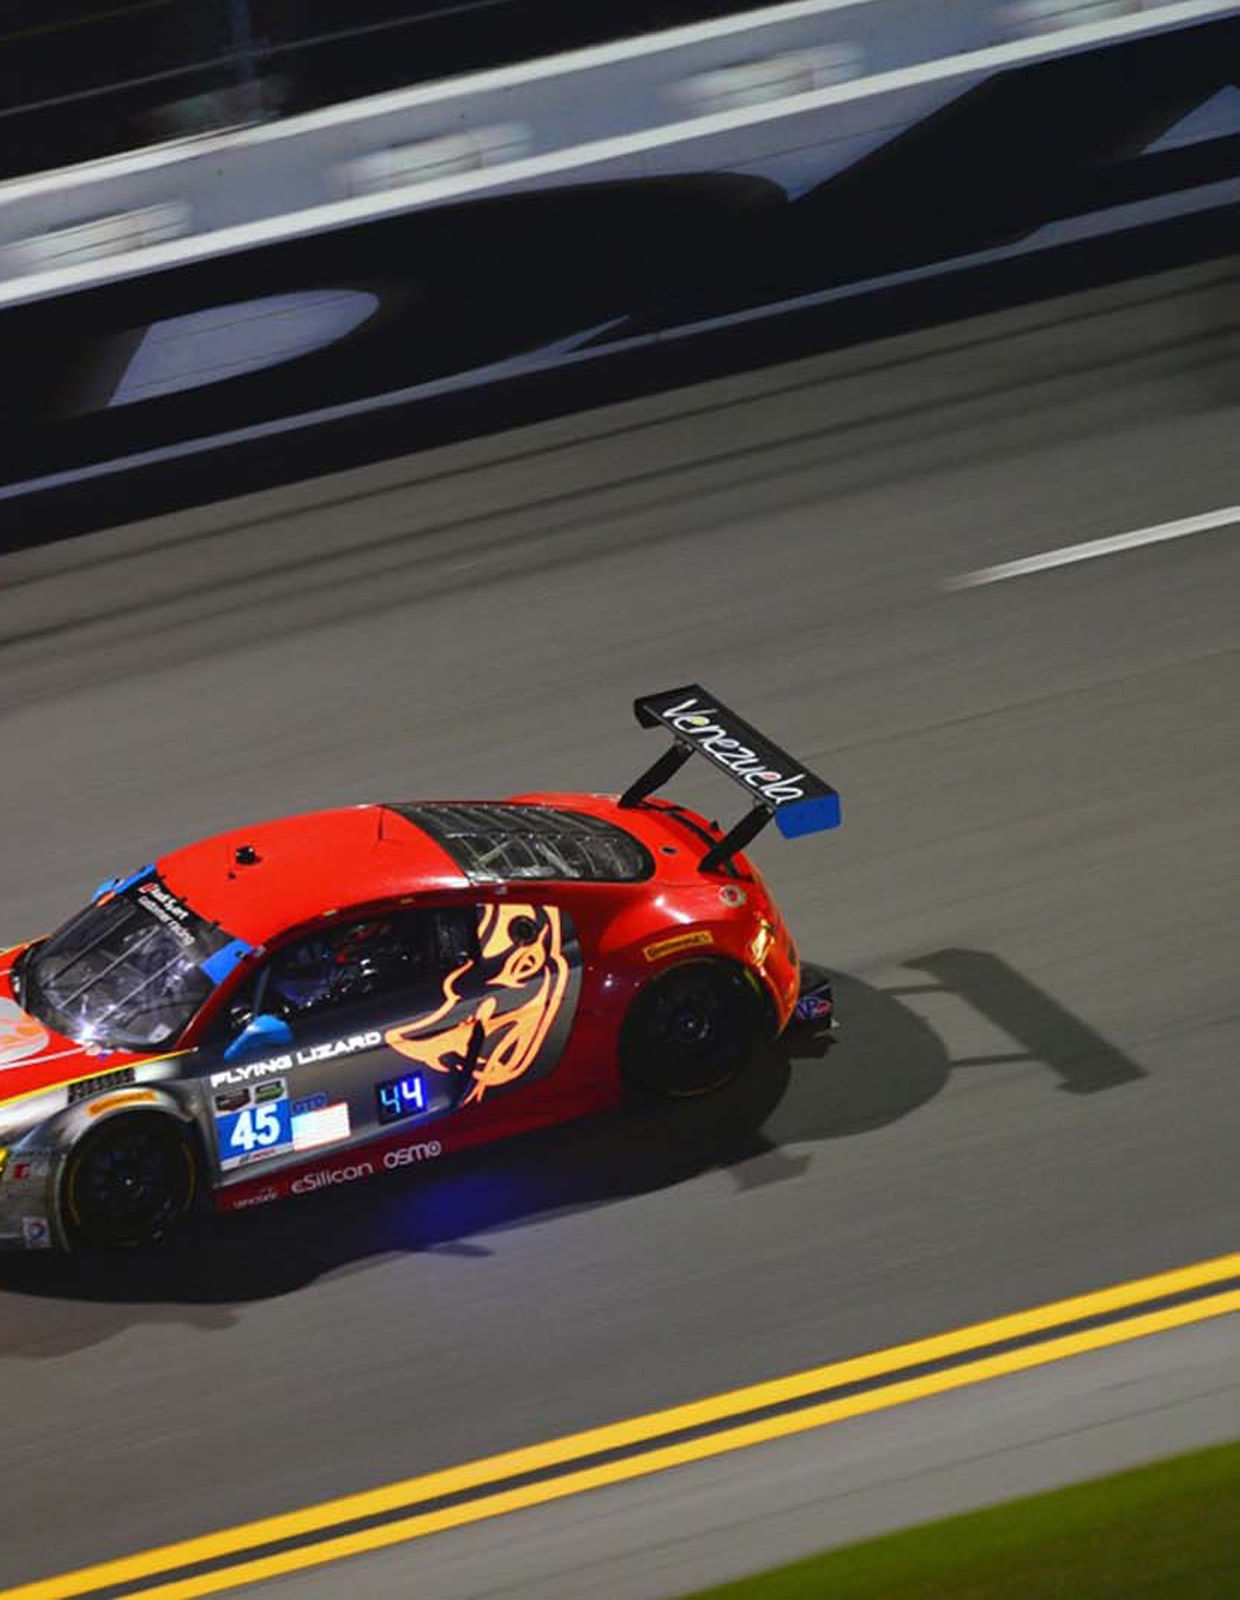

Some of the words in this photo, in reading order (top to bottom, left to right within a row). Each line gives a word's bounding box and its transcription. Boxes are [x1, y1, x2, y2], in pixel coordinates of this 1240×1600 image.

[662, 698, 806, 804] Venezuela
[210, 1055, 293, 1088] FLYING
[296, 1031, 382, 1065] LIZARD
[379, 1077, 424, 1114] 44
[230, 1103, 281, 1150] 45
[290, 1162, 374, 1194] eSilicon
